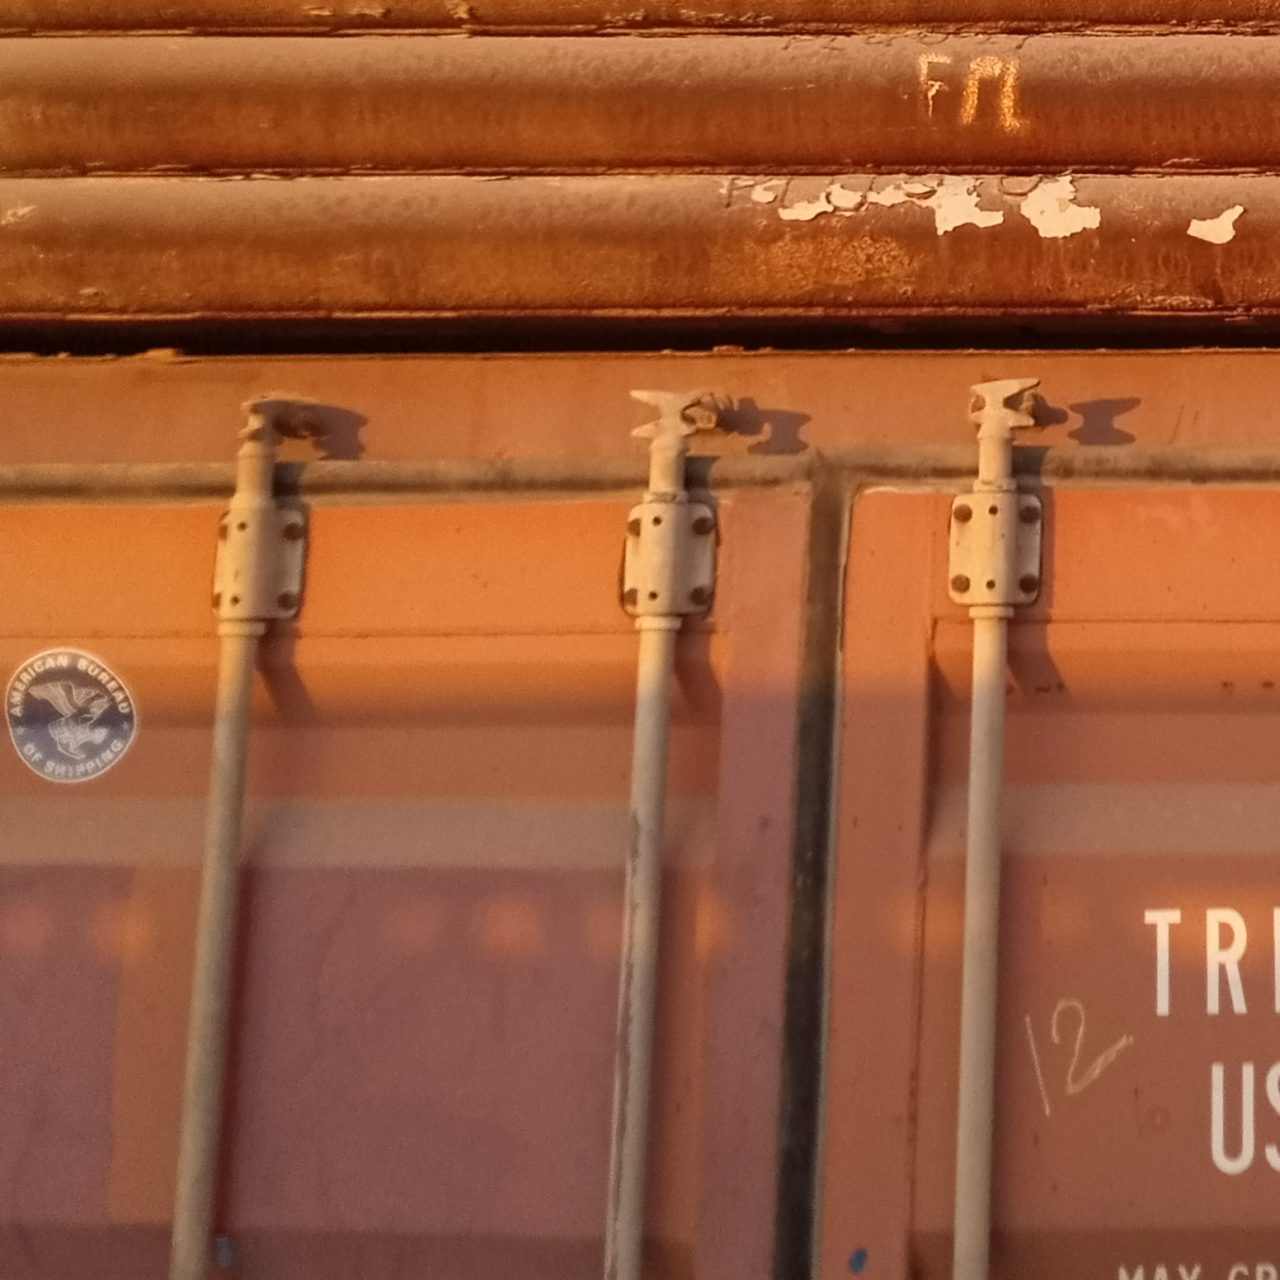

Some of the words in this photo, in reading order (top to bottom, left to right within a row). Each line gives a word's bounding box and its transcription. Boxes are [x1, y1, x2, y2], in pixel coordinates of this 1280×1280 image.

[10, 654, 69, 718] AMERICAN
[76, 657, 131, 714] BUREAU
[23, 741, 43, 763] OF
[43, 738, 123, 778] SHIPPING
[1023, 998, 1135, 1117] 12
